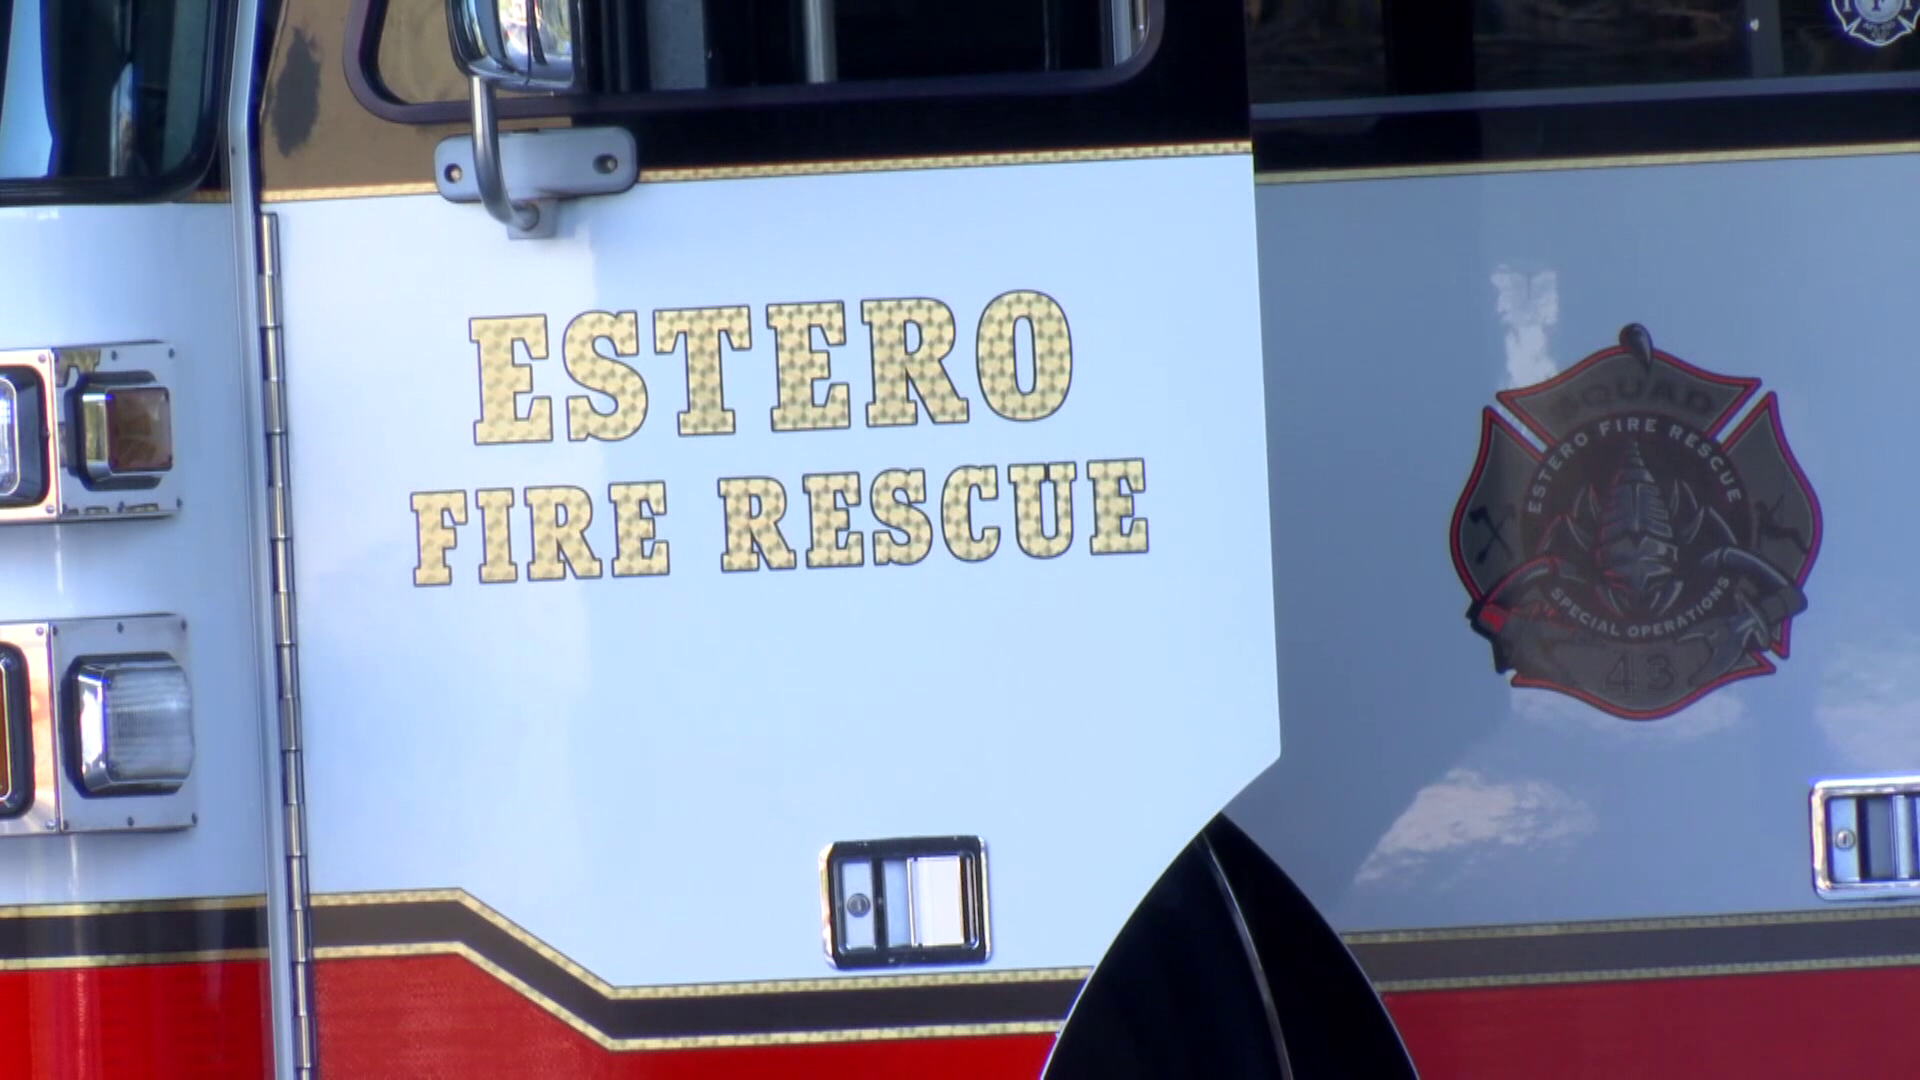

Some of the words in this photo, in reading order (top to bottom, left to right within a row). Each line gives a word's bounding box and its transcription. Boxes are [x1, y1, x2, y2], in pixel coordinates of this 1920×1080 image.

[469, 290, 1073, 445] ESTERO
[1549, 376, 1714, 418] SQUAD
[1528, 432, 1588, 514] ESTERO
[1599, 417, 1657, 436] FIRE
[1669, 424, 1741, 502] RESCUE
[410, 481, 670, 587] FIRE
[718, 458, 1149, 573] RESCUE
[1551, 587, 1620, 637] SPECIAL
[1628, 575, 1730, 638] OPERATIONS
[1602, 652, 1675, 693] 43
